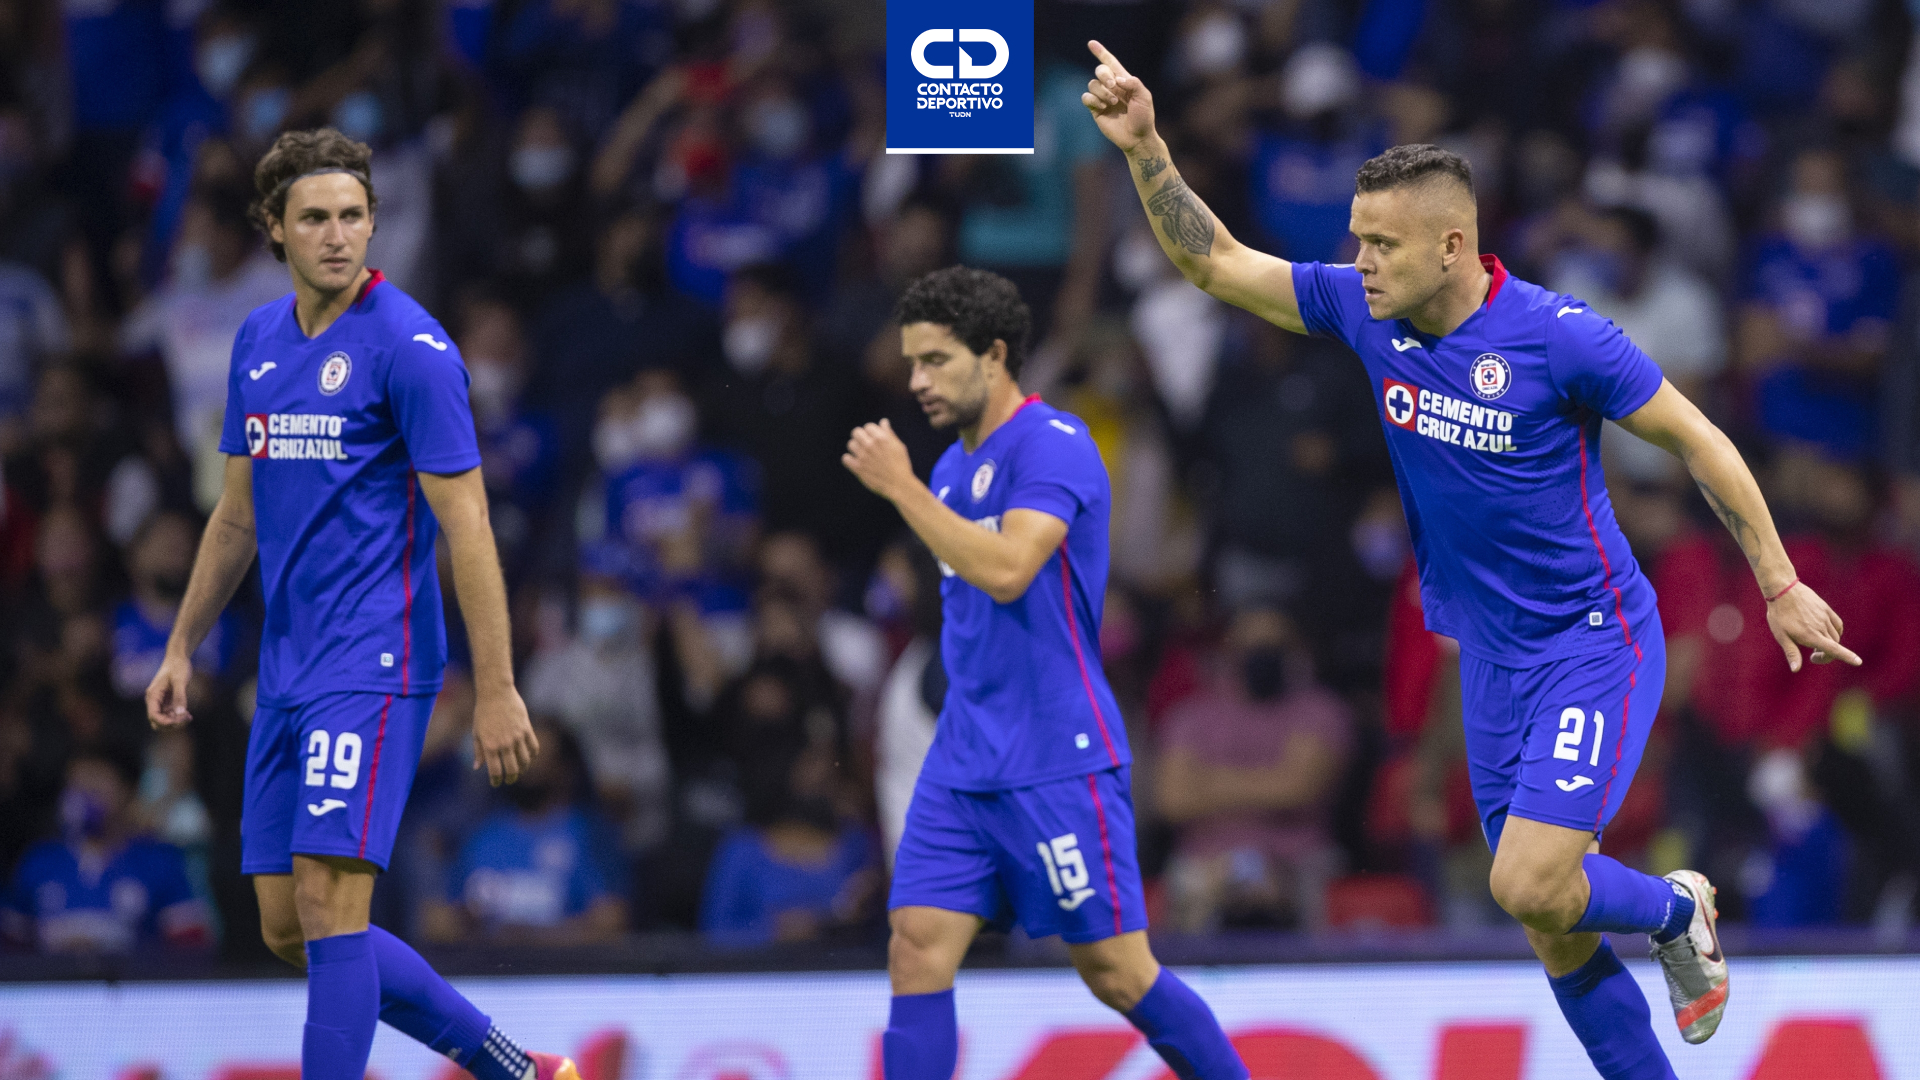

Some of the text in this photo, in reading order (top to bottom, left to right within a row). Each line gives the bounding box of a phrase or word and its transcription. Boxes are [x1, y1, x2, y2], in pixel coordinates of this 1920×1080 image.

[268, 413, 342, 438] CEMENTO
[1418, 389, 1513, 432] CEMENTO
[268, 437, 348, 460] CRUZ AZUL
[1416, 413, 1517, 454] CRUZ AZUL
[1553, 707, 1605, 767] 21
[305, 729, 363, 790] 29
[1036, 832, 1090, 896] 15
